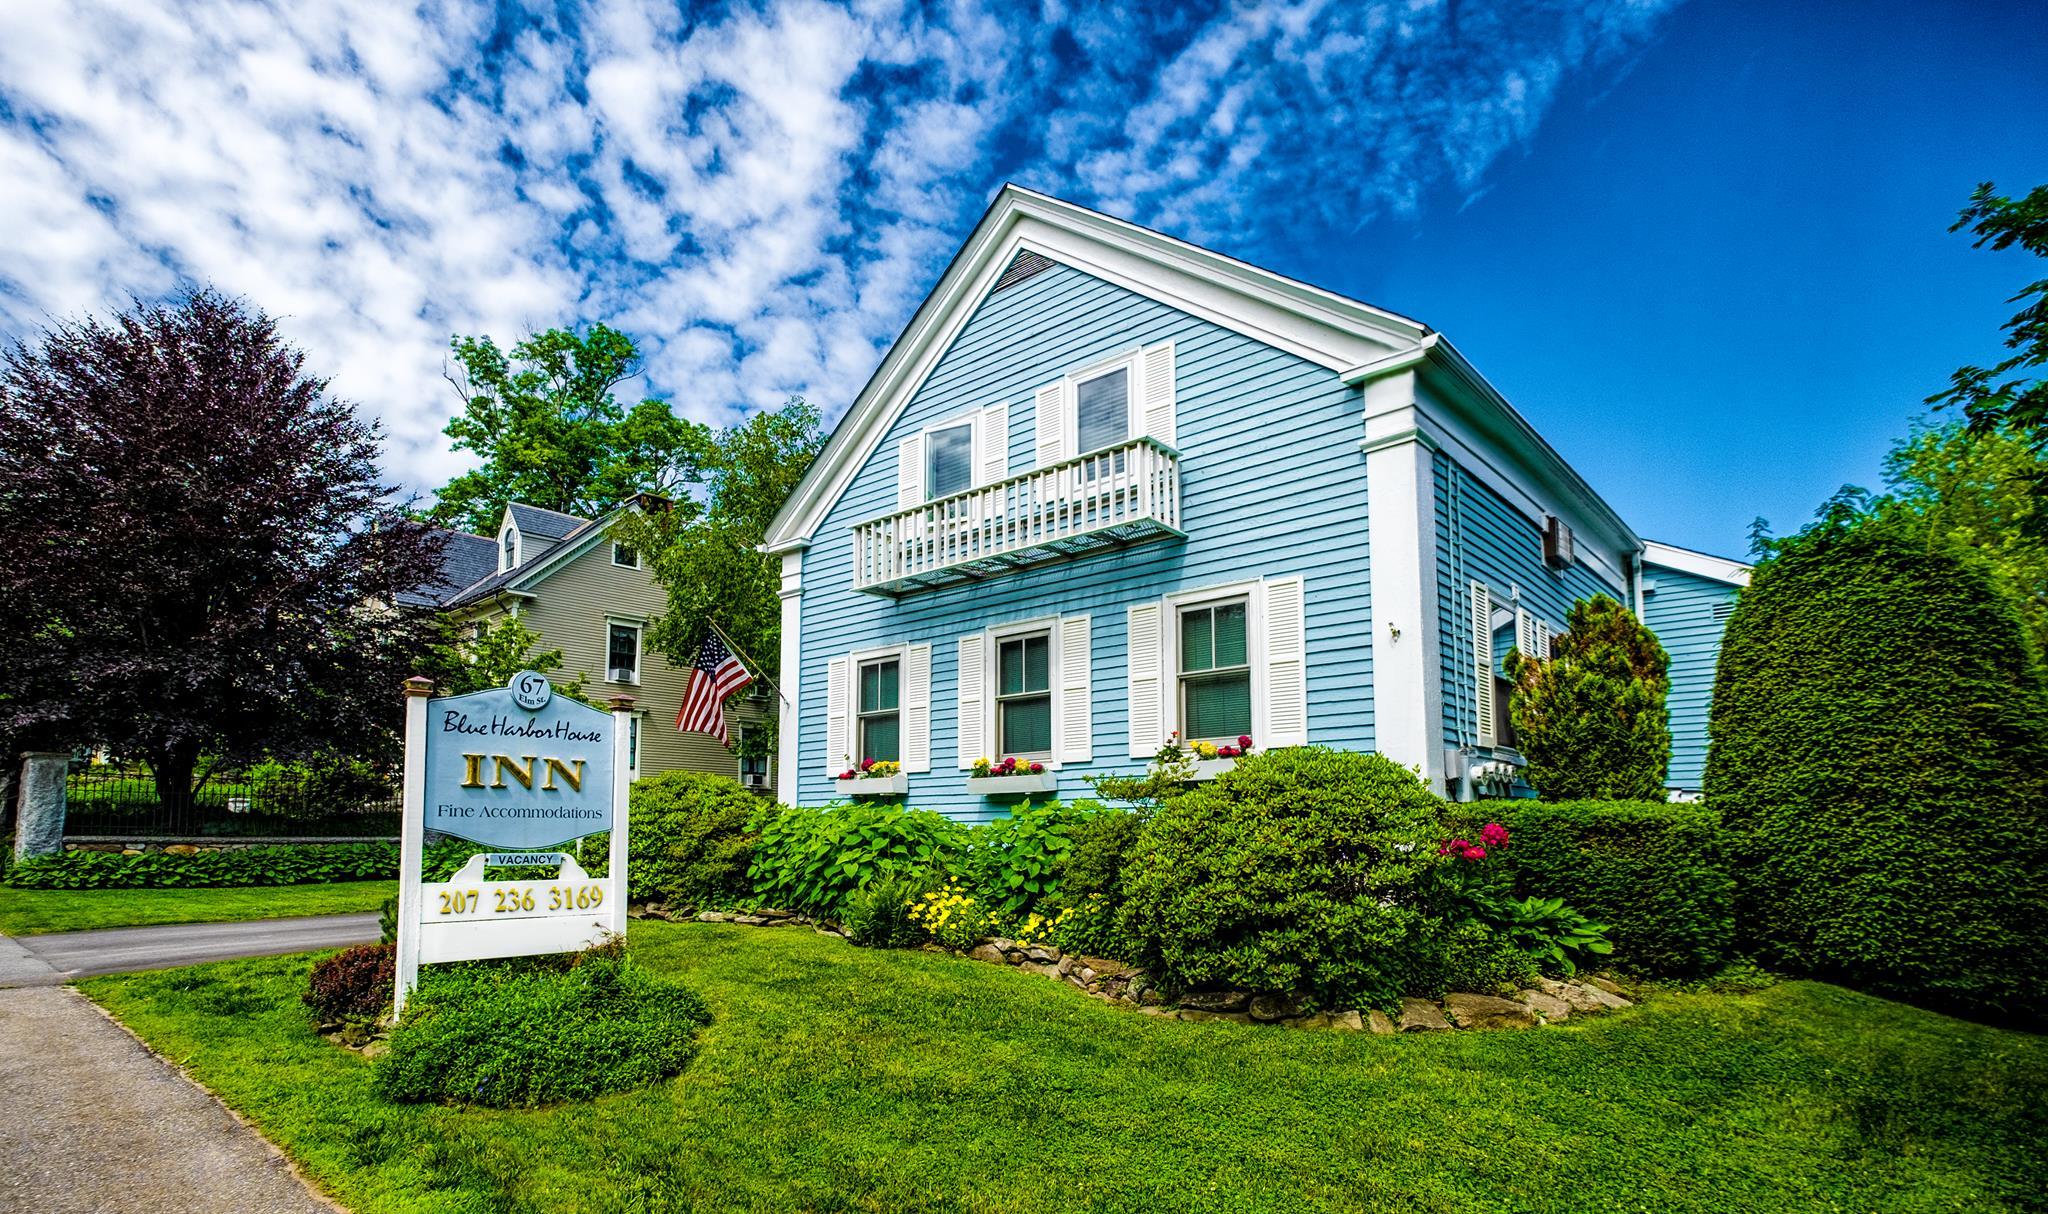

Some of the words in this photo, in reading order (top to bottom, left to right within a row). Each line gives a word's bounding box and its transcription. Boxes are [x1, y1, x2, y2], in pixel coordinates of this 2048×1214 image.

[520, 675, 545, 695] 67
[519, 694, 534, 705] Elm
[443, 710, 488, 735] Blue
[491, 715, 553, 739] Harbor
[556, 721, 602, 742] House
[461, 753, 586, 792] INN
[438, 804, 475, 818] Fine
[479, 805, 603, 819] Accommodations
[499, 855, 554, 865] VACANCY
[439, 890, 479, 914] 207
[494, 888, 535, 912] 236
[548, 885, 603, 910] 3169
